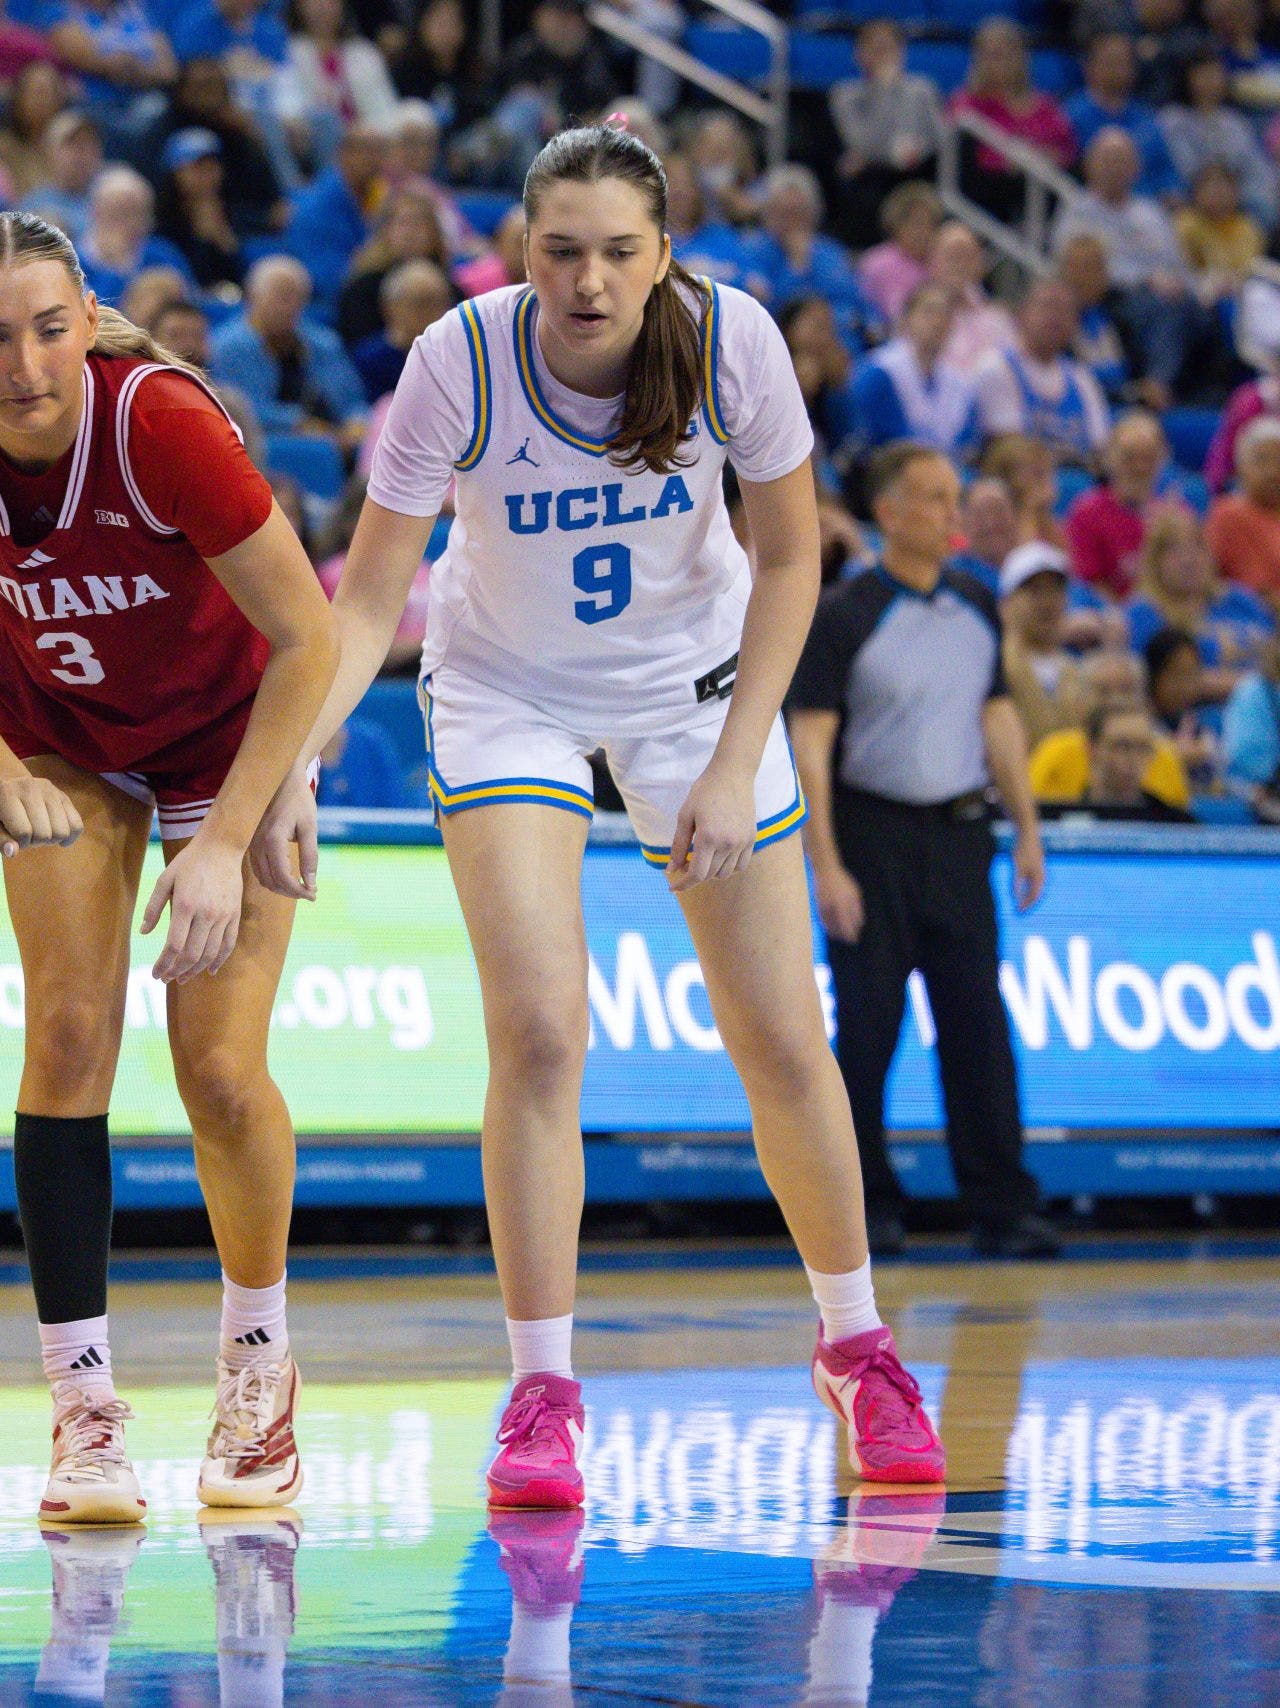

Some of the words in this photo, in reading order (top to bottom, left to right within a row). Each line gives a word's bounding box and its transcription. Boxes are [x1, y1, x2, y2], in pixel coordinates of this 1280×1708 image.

[505, 475, 694, 534] UCLA
[573, 542, 631, 625] 9
[35, 631, 106, 685] 3
